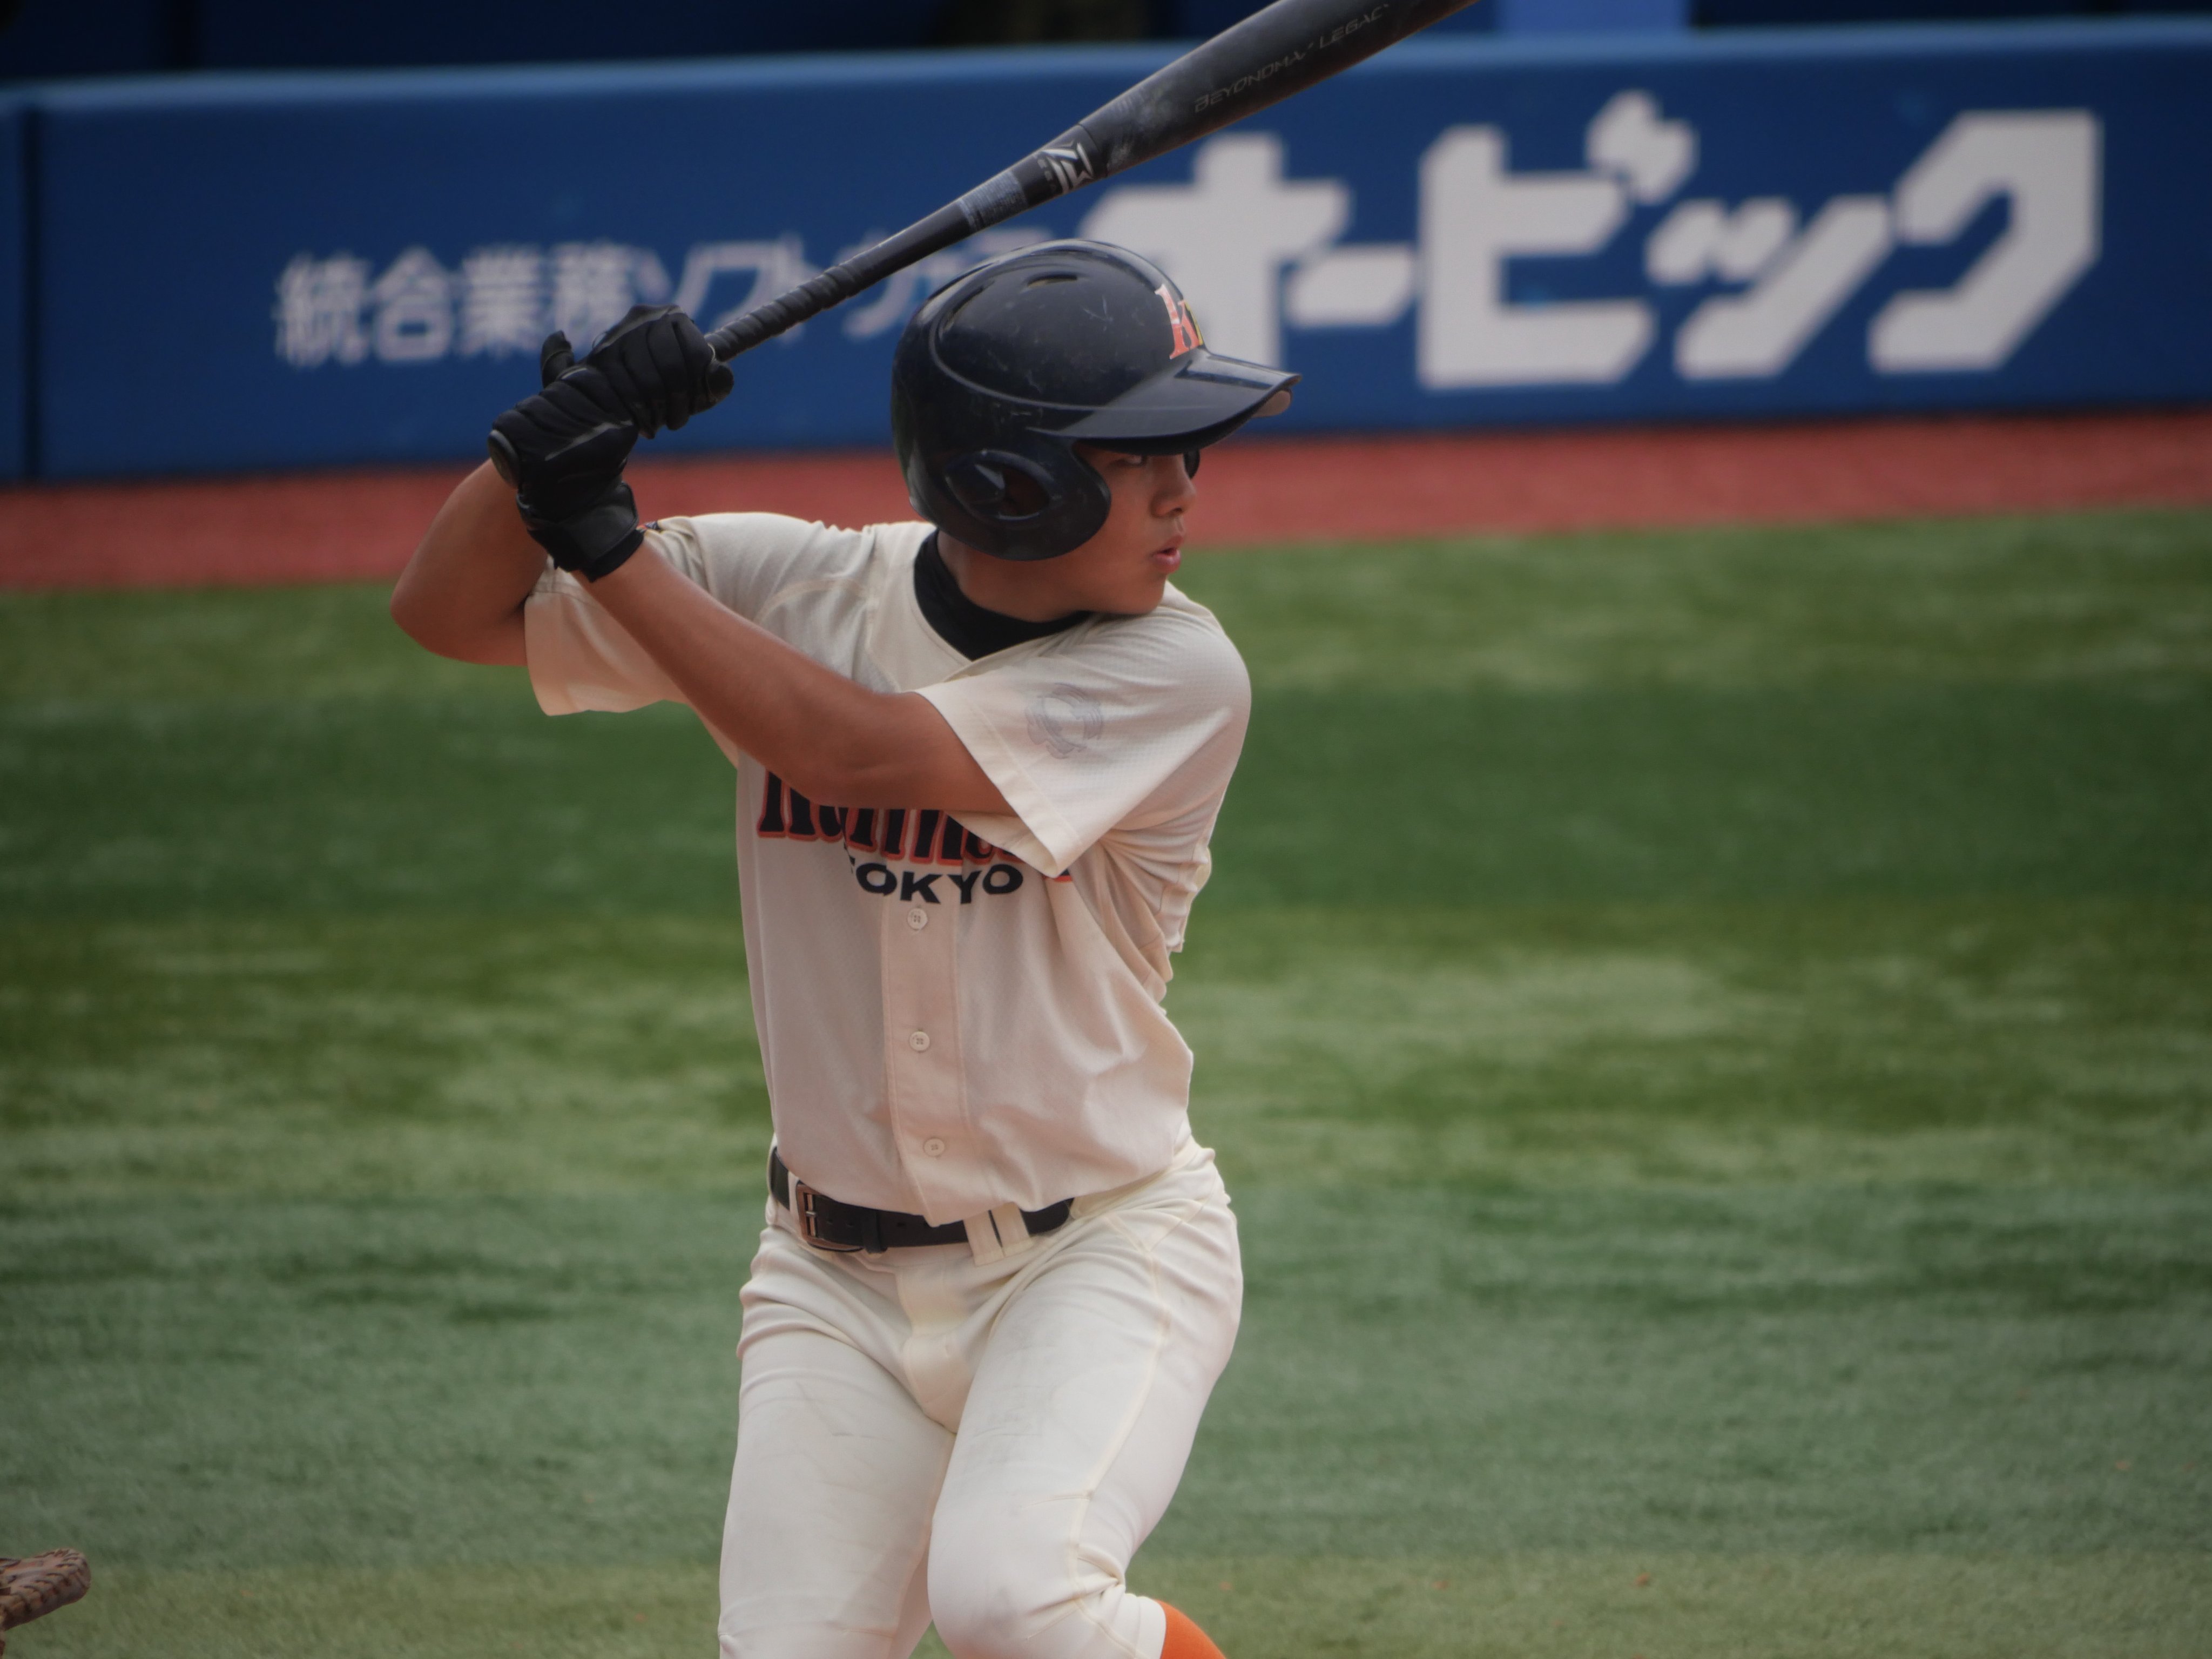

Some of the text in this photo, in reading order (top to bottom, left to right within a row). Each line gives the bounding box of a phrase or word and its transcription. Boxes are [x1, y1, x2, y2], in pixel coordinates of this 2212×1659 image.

[1319, 3, 1390, 49] LEGAC
[1080, 91, 2104, 390] オービック
[847, 855, 1024, 905] OKYO
